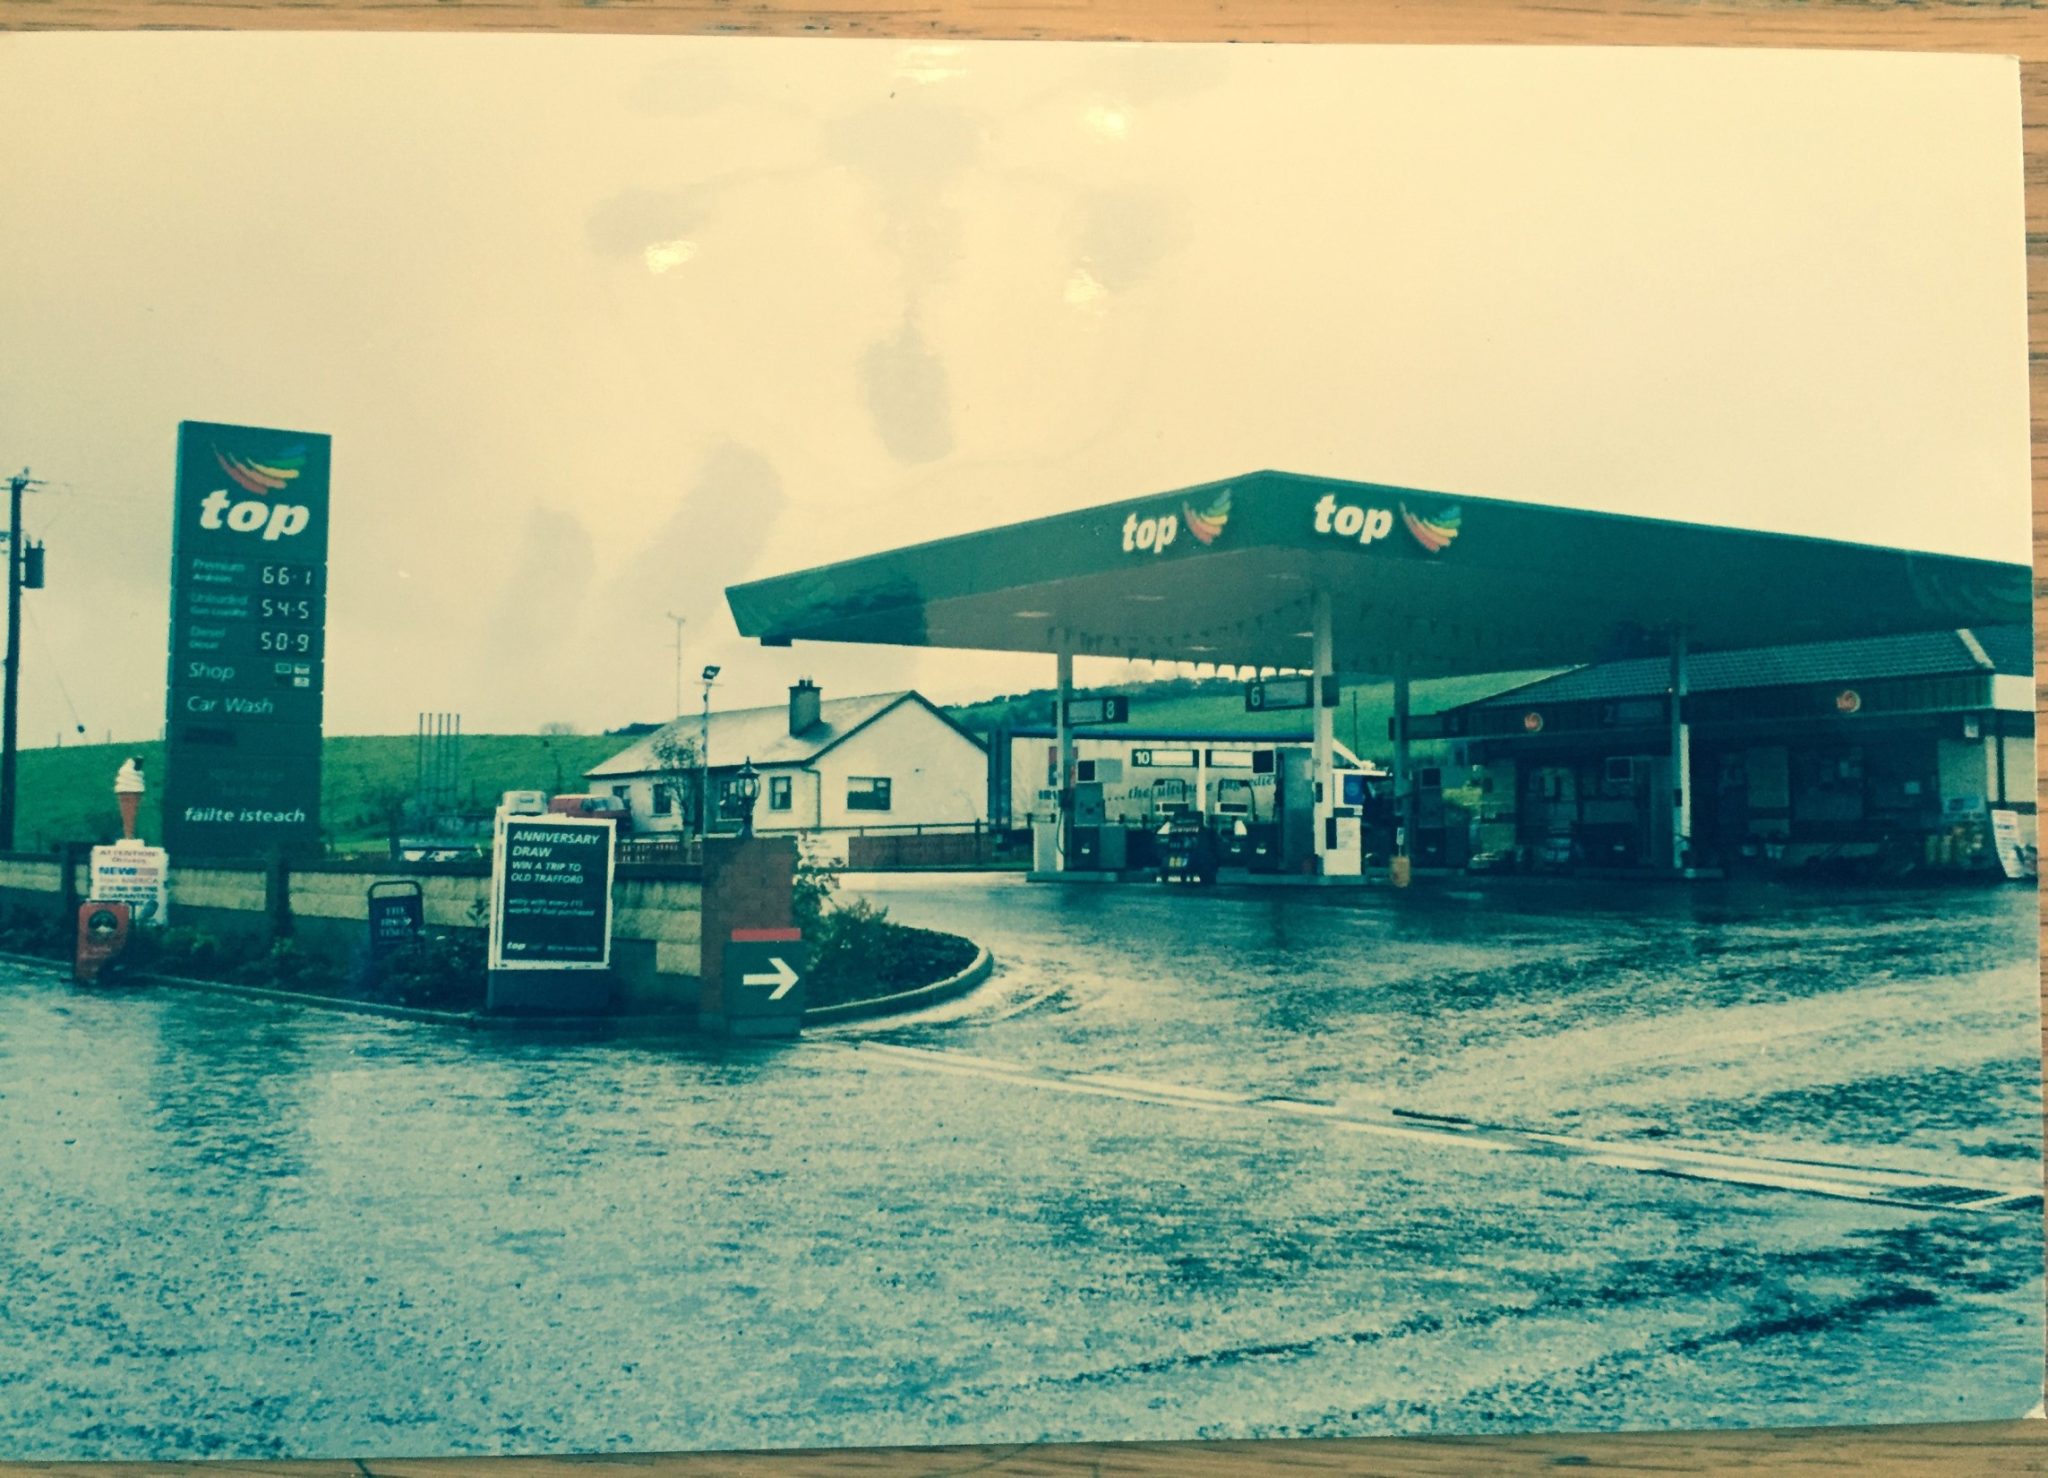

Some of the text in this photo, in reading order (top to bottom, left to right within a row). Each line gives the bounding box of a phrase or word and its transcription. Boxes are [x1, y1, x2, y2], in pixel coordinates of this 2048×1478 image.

[200, 489, 310, 541] top
[1314, 495, 1392, 544] top
[1122, 512, 1178, 554] top
[189, 662, 235, 681] Shop
[187, 696, 273, 713] Car Wash
[1251, 686, 1260, 706] 6
[1106, 701, 1115, 719] 8
[1135, 750, 1150, 765] 10
[239, 807, 305, 822] isteach
[513, 830, 600, 845] ANNIVERSARY
[512, 846, 552, 858] DRAW
[512, 861, 582, 873] WIN A TRIP TO
[510, 872, 584, 885] OLD TRAFFORD
